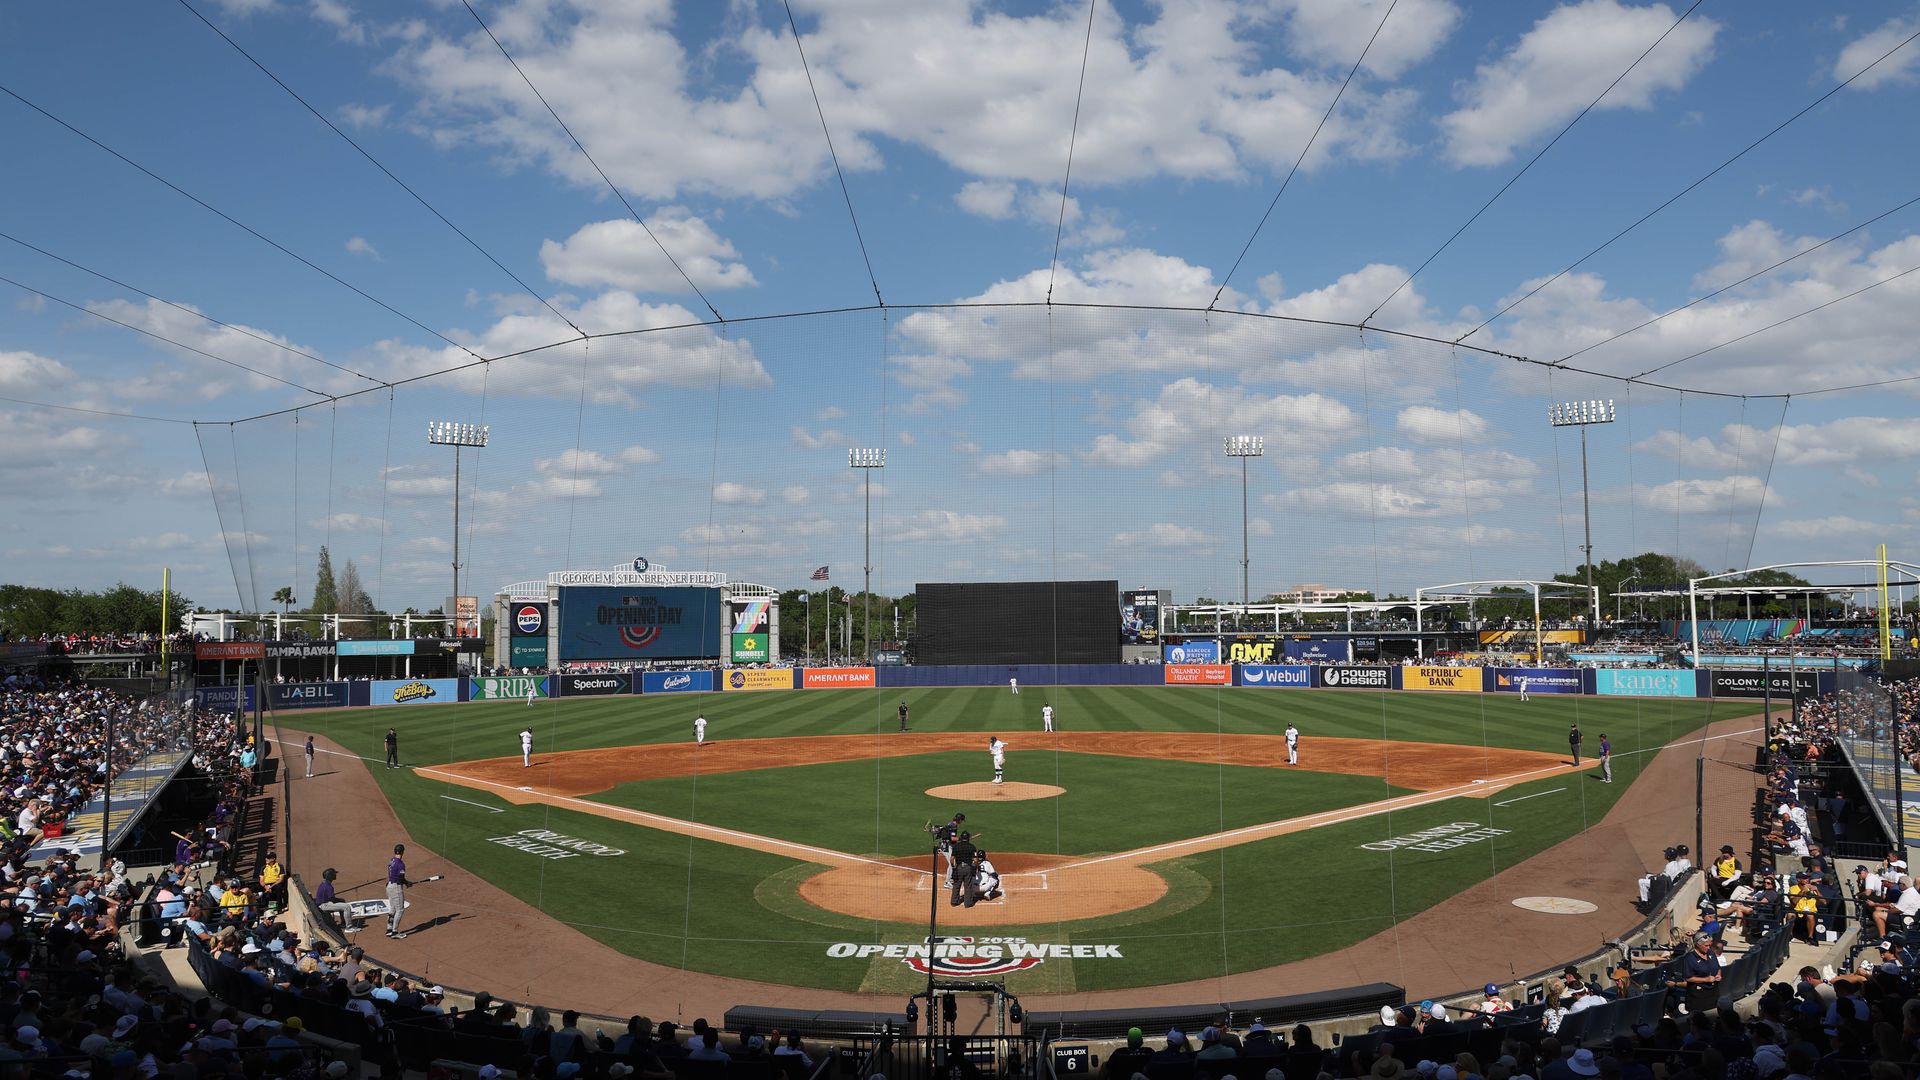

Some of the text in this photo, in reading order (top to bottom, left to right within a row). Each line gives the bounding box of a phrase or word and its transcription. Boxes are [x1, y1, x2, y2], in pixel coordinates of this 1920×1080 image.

[636, 558, 646, 570] TB
[562, 574, 716, 583] GEORGE M. STEINBRENNER FIELD
[597, 605, 682, 624] OPENING DAY
[201, 646, 260, 656] AMERANT BANK
[266, 647, 302, 656] TAMPA
[1230, 643, 1274, 661] GMF
[1266, 670, 1306, 682] Webull
[1420, 669, 1463, 678] REPUBLIC
[574, 680, 617, 690] Spectrum
[1429, 678, 1454, 686] BANK
[1613, 671, 1678, 689] kane's
[282, 687, 333, 698] JABIL
[500, 679, 538, 698] RIPA
[207, 690, 248, 701] FANDUL
[1360, 822, 1480, 850] ORLANDO
[1405, 827, 1512, 852] HEALTH
[486, 835, 581, 860] HEALTH
[518, 829, 626, 856] ORLANDO
[826, 942, 1124, 958] OPENING WEEK
[1068, 1058, 1076, 1070] 6
